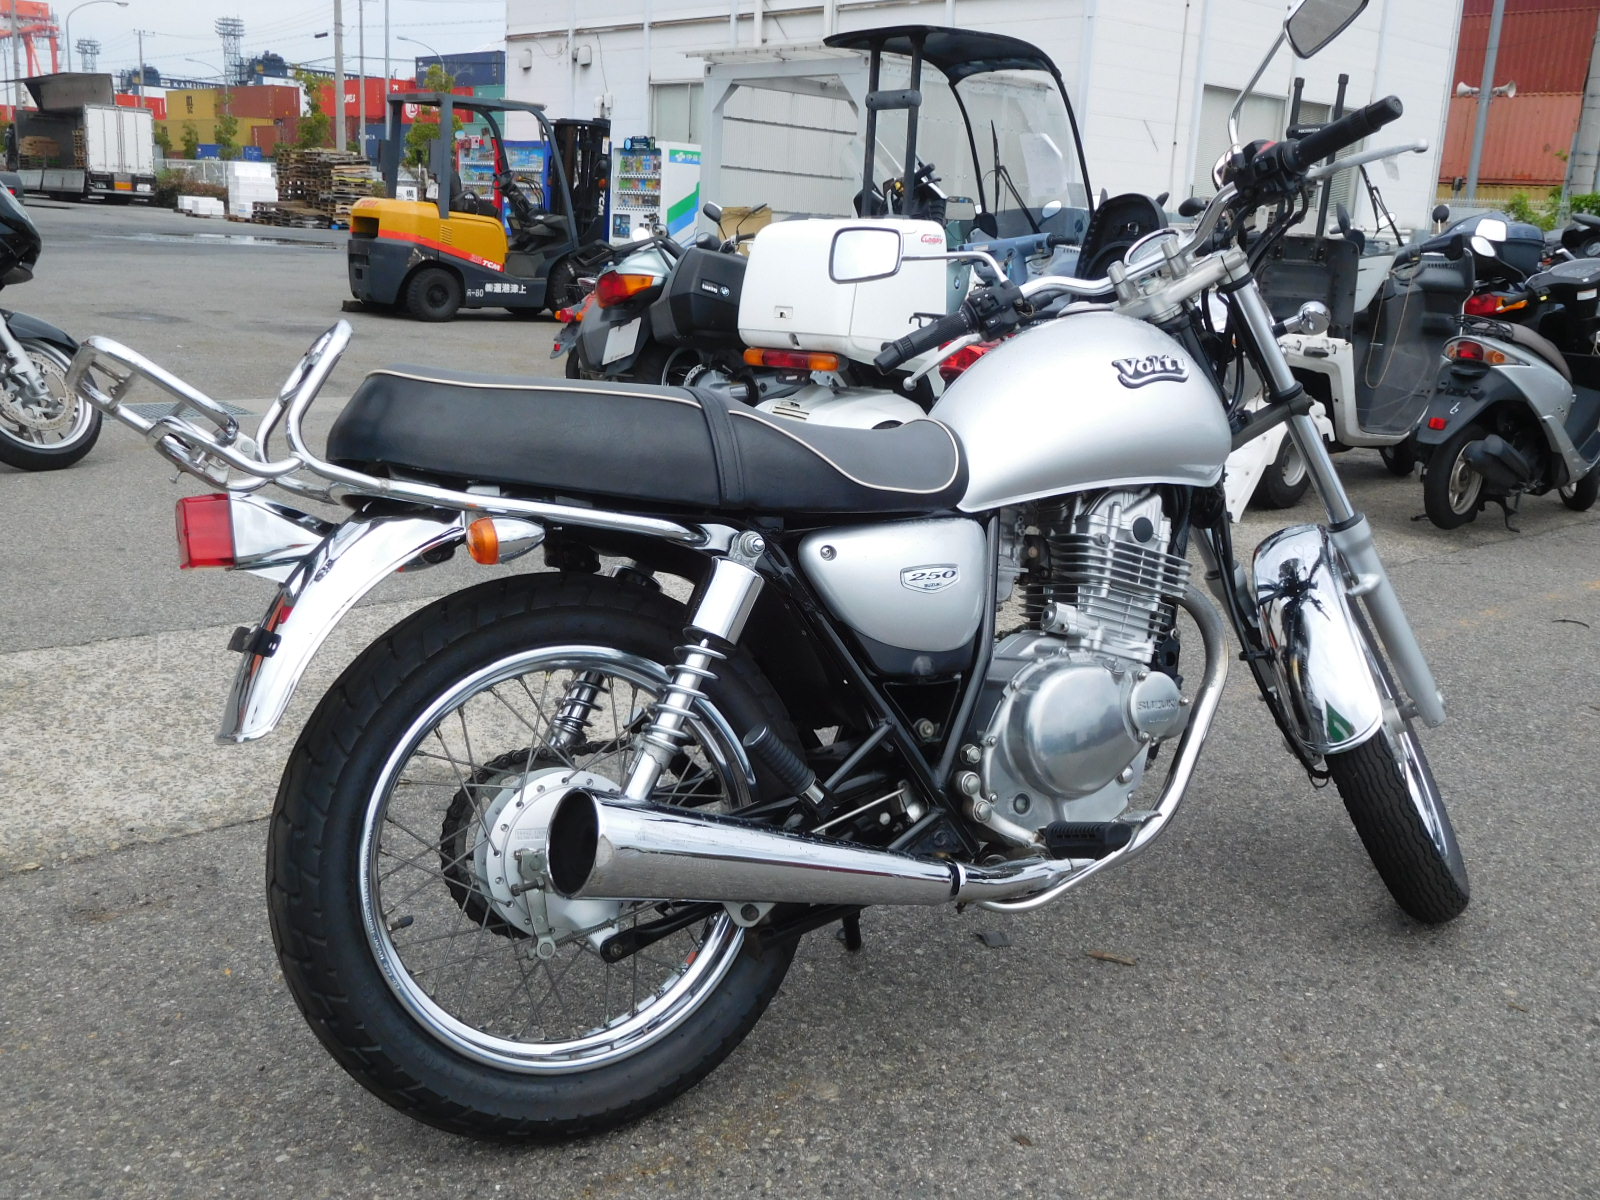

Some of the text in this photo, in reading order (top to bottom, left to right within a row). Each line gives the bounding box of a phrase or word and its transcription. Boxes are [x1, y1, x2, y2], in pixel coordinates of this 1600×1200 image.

[597, 190, 606, 216] TCM
[482, 259, 501, 272] TCM
[1111, 355, 1190, 389] Volty
[909, 570, 957, 582] 250
[1136, 698, 1178, 711] SUZUKI
